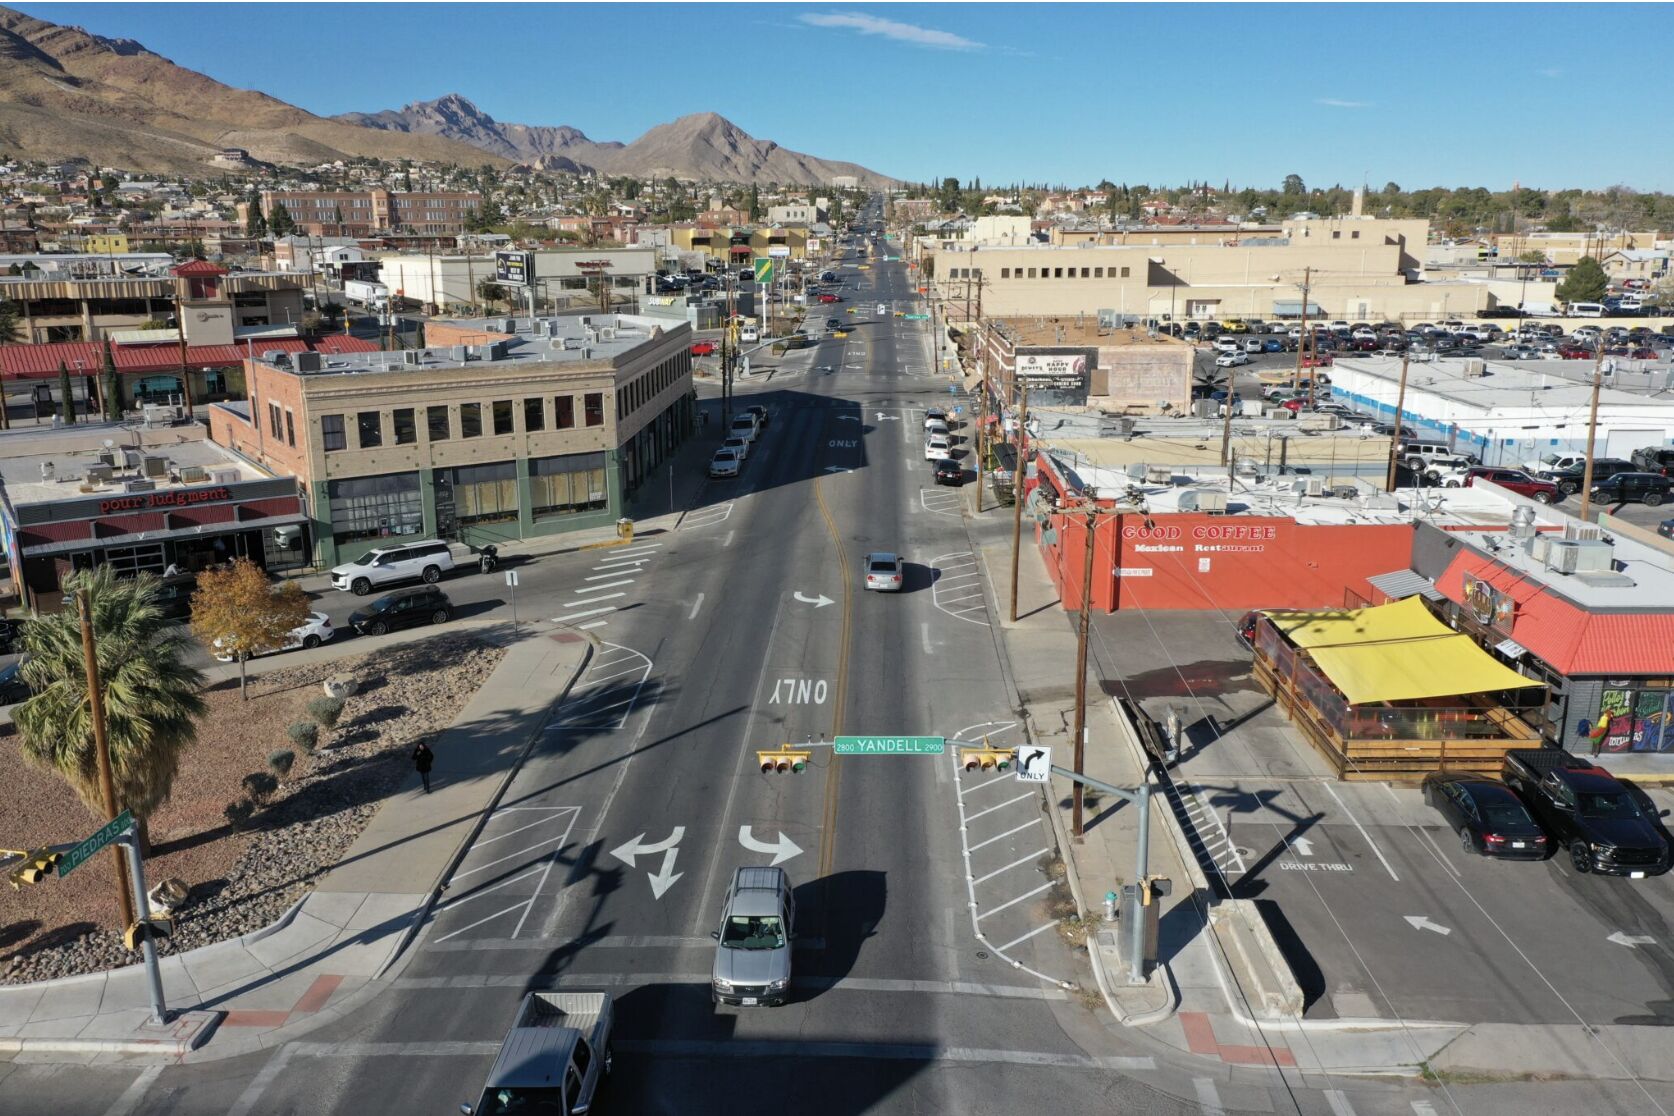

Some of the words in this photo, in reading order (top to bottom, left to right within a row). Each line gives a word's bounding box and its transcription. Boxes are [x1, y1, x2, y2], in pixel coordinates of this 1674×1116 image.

[829, 440, 858, 448] ONLY
[100, 497, 141, 513] pour
[1122, 526, 1181, 539] GOOD
[1192, 526, 1276, 539] COFFEE
[768, 679, 828, 704] ONLY
[837, 743, 855, 751] 2800
[857, 740, 922, 752] YANDELL
[924, 743, 943, 751] 2900
[1020, 772, 1045, 780] ONLY
[71, 820, 120, 866] PIEDRAS
[1279, 863, 1318, 871] DRIVE
[1318, 863, 1353, 871] THRU
